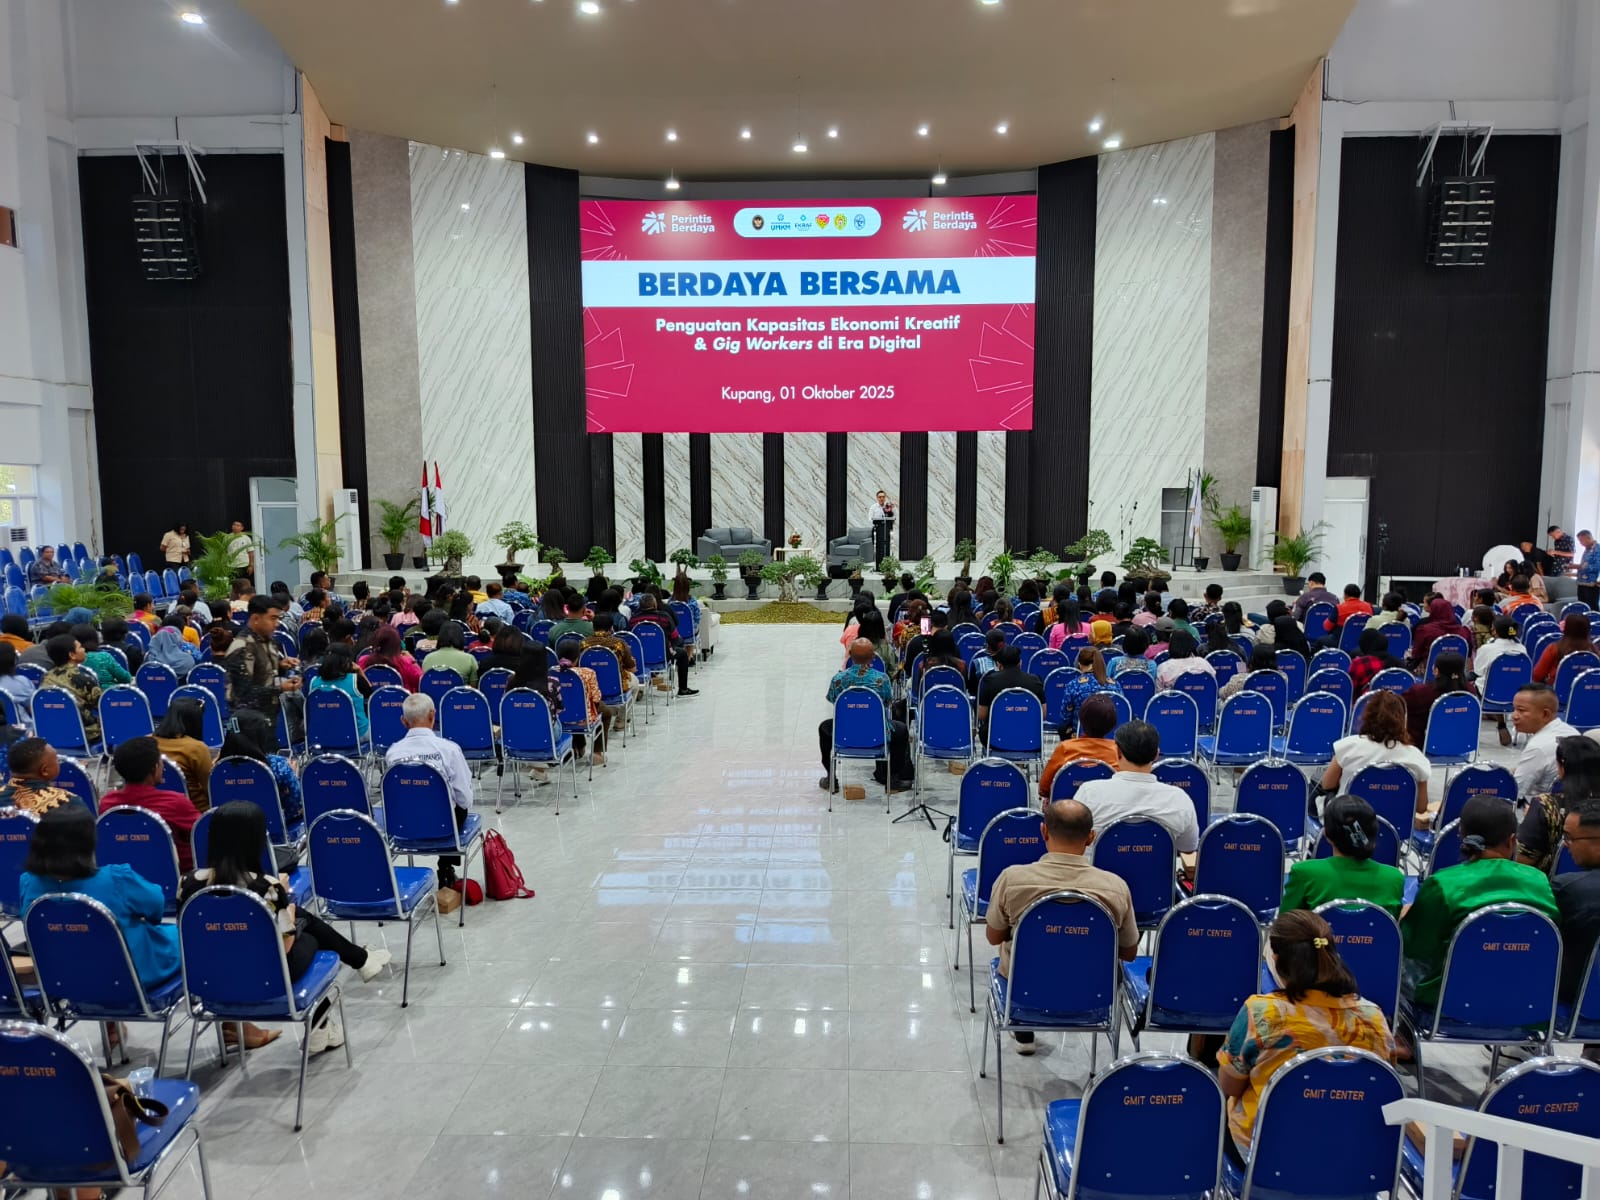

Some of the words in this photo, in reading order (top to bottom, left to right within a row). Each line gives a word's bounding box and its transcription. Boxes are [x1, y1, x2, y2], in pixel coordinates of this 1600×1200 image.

[672, 214, 712, 224] Perintis
[933, 210, 974, 220] Perintis
[672, 224, 715, 234] Berdaya
[933, 220, 977, 230] Berdaya
[638, 271, 788, 297] BERDAYA
[800, 269, 961, 296] BERSAMA
[656, 318, 742, 334] Penguatan
[747, 318, 825, 334] Kapasitas
[830, 316, 900, 331] Ekonomi
[905, 315, 960, 330] Kreatif
[694, 337, 707, 351] &
[713, 337, 740, 354] Gig
[746, 336, 813, 351] Workers
[818, 336, 832, 350] di
[838, 336, 864, 350] Era
[869, 334, 921, 352] Digital
[722, 386, 776, 404] Kupang,
[780, 386, 796, 400] 01
[802, 385, 854, 400] Oktober
[860, 386, 894, 399] 2025
[1064, 926, 1089, 934] CENTER
[1332, 935, 1344, 943] MIT
[1347, 936, 1373, 944] CENTER
[0, 1066, 19, 1075] GMIT
[24, 1067, 56, 1077] CENTER
[1304, 1088, 1326, 1098] GMIT
[1330, 1090, 1364, 1100] CENTER
[1124, 1096, 1145, 1105] GMIT
[1150, 1095, 1183, 1104] CENTER
[1518, 1102, 1541, 1114] GMIT
[1544, 1101, 1579, 1113] CENTER
